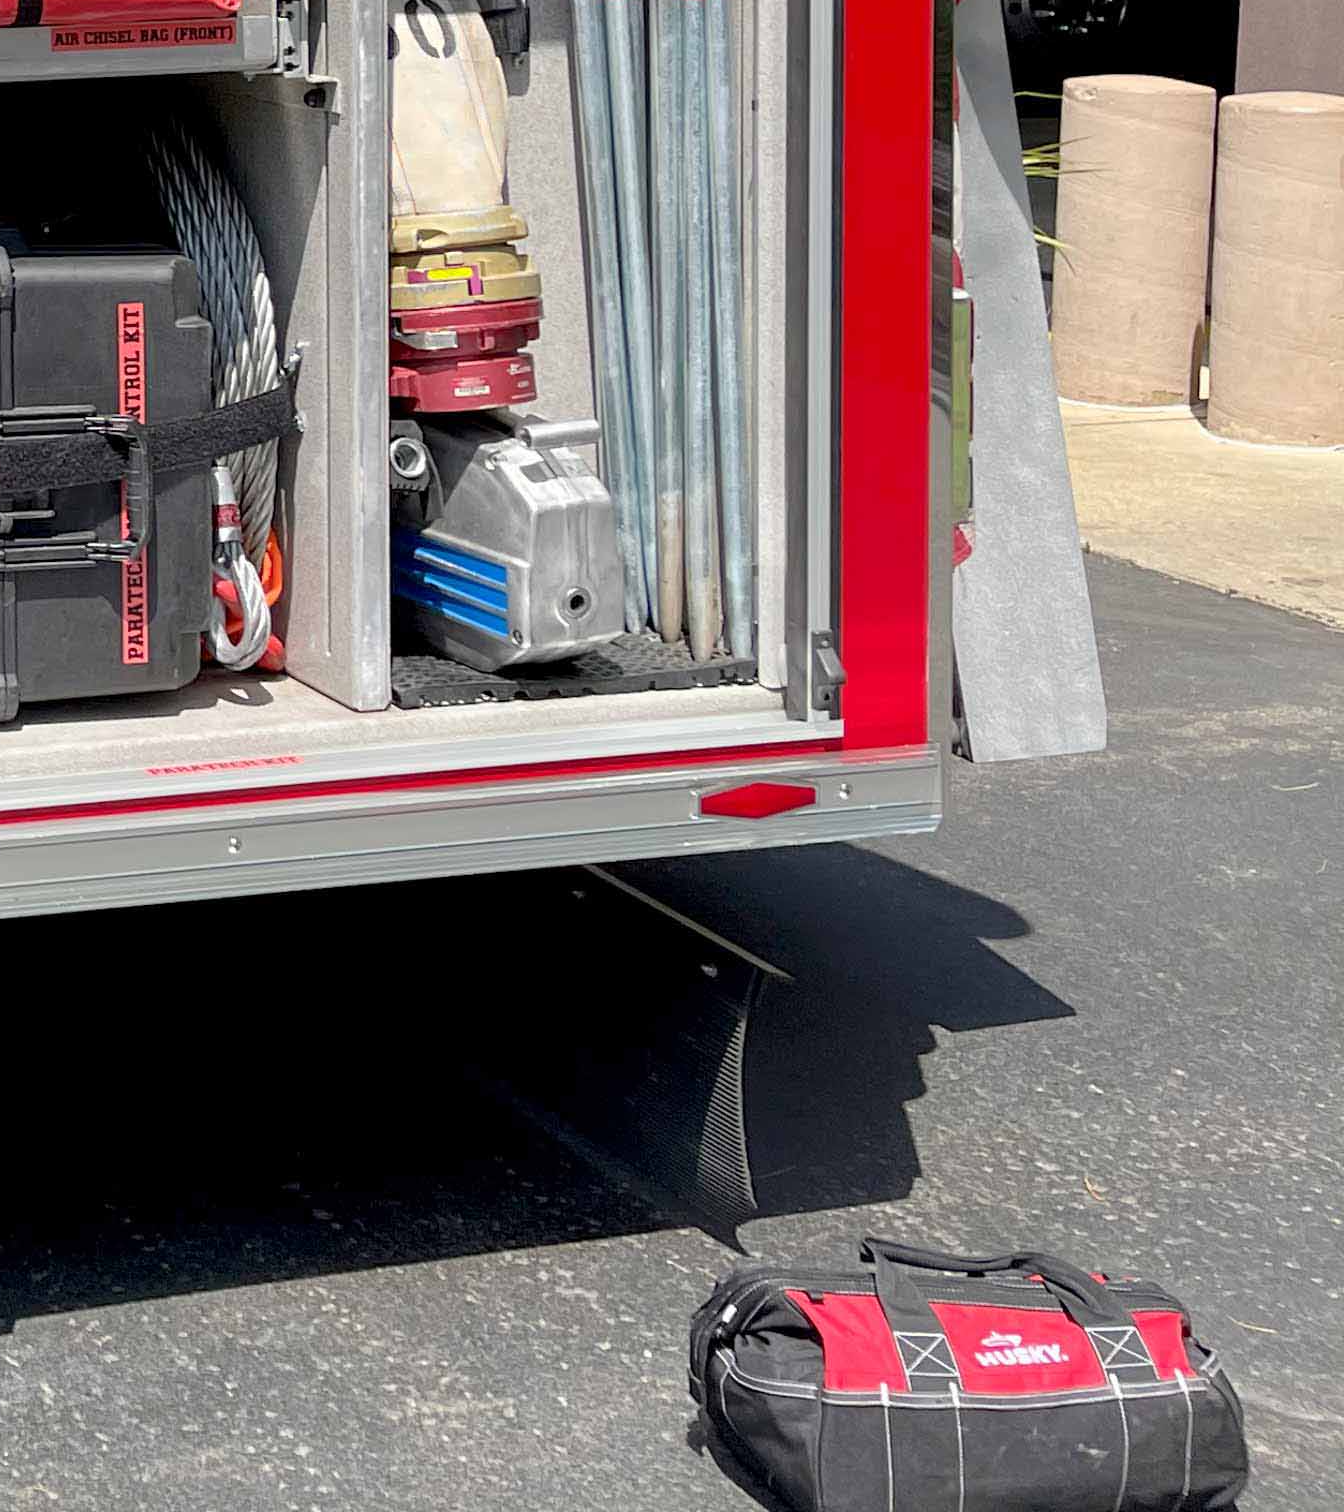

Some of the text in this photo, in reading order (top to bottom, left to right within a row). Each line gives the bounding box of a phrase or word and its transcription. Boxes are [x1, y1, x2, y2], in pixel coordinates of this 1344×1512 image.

[54, 24, 234, 47] AIR CHISEL BAG (FRONT)
[122, 308, 144, 660] PARATEC NTROL KIT
